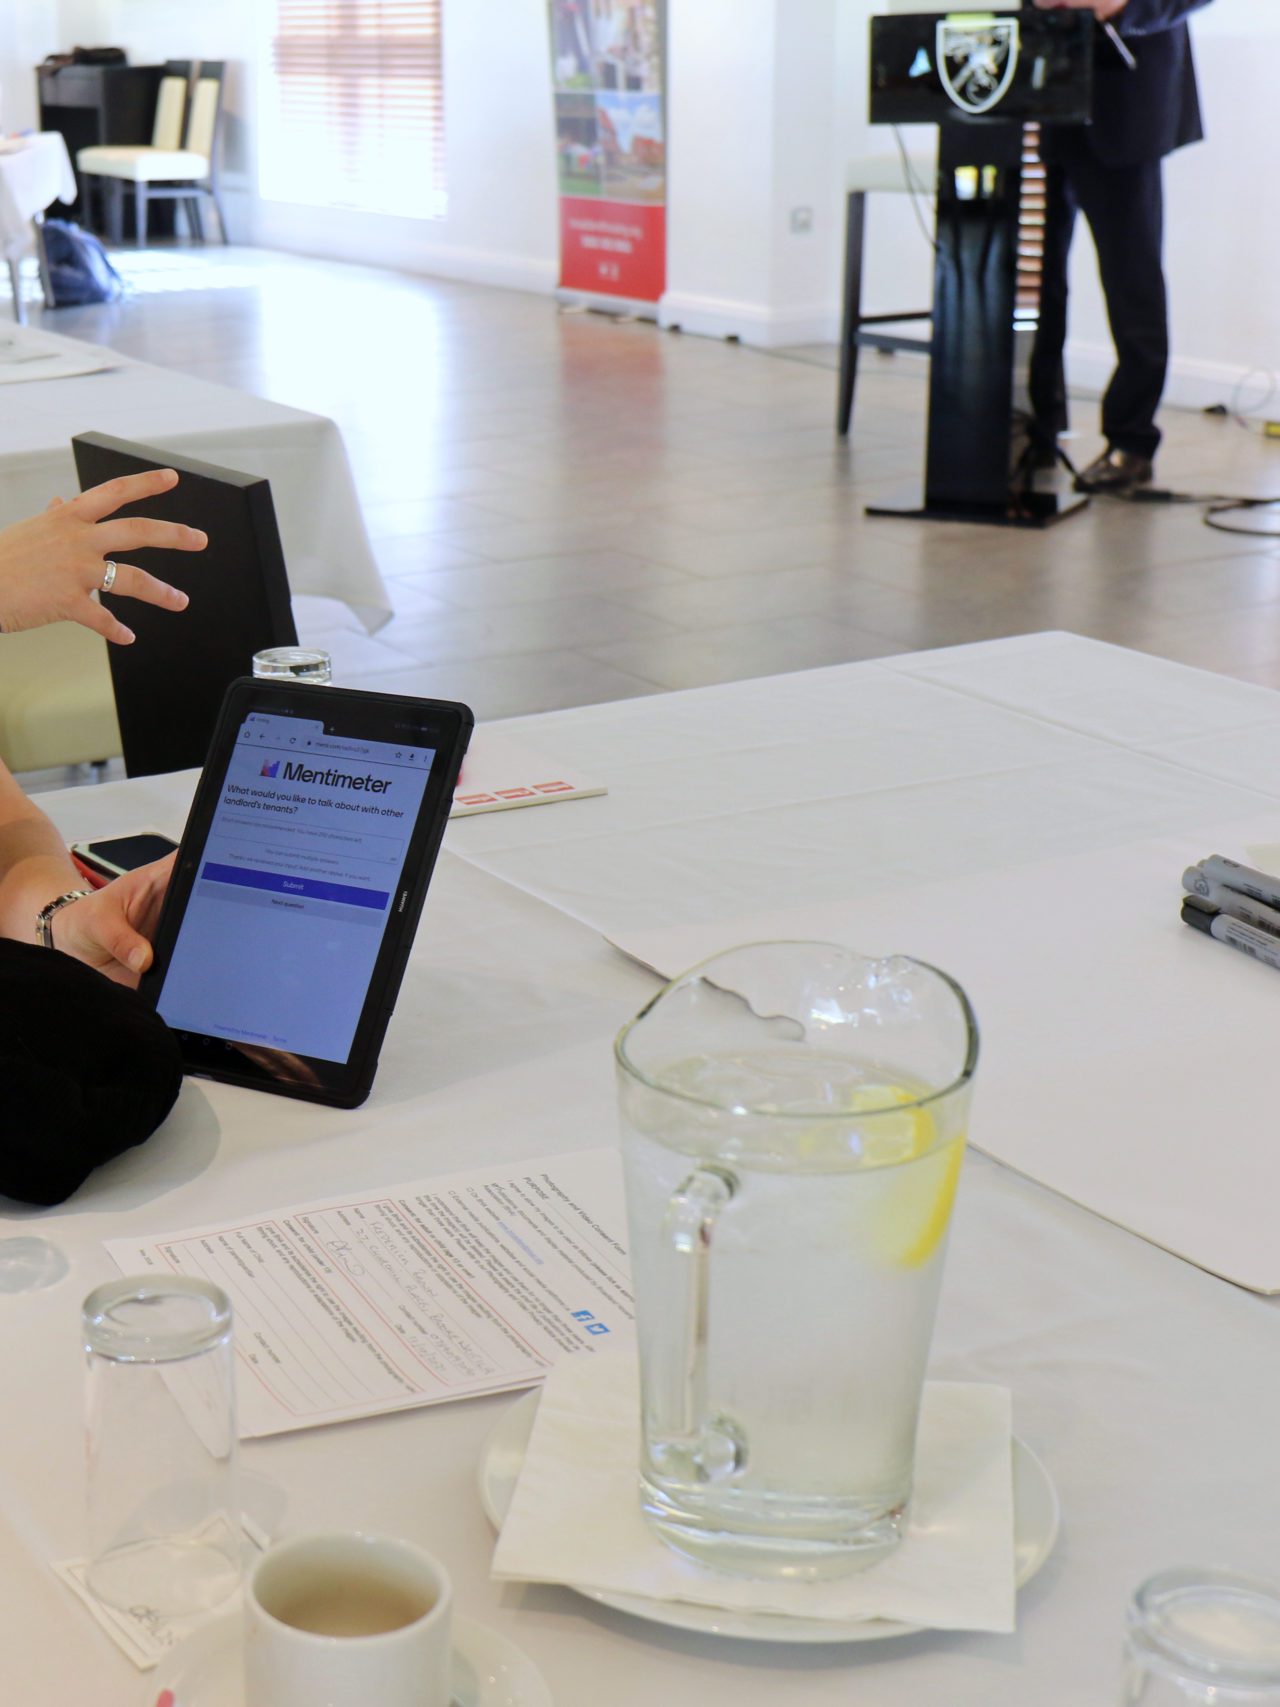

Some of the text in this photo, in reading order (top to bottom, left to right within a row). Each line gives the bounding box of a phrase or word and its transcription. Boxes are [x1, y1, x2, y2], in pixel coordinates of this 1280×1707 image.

[282, 761, 392, 794] Mentimeter
[223, 796, 298, 814] landlord's tenants?
[227, 784, 404, 818] What would you like to talk about with other
[282, 880, 304, 890] Submit
[522, 1176, 549, 1200] PURPOSE
[568, 1202, 581, 1211] and
[577, 1210, 593, 1224] Video
[611, 1242, 627, 1255] Form
